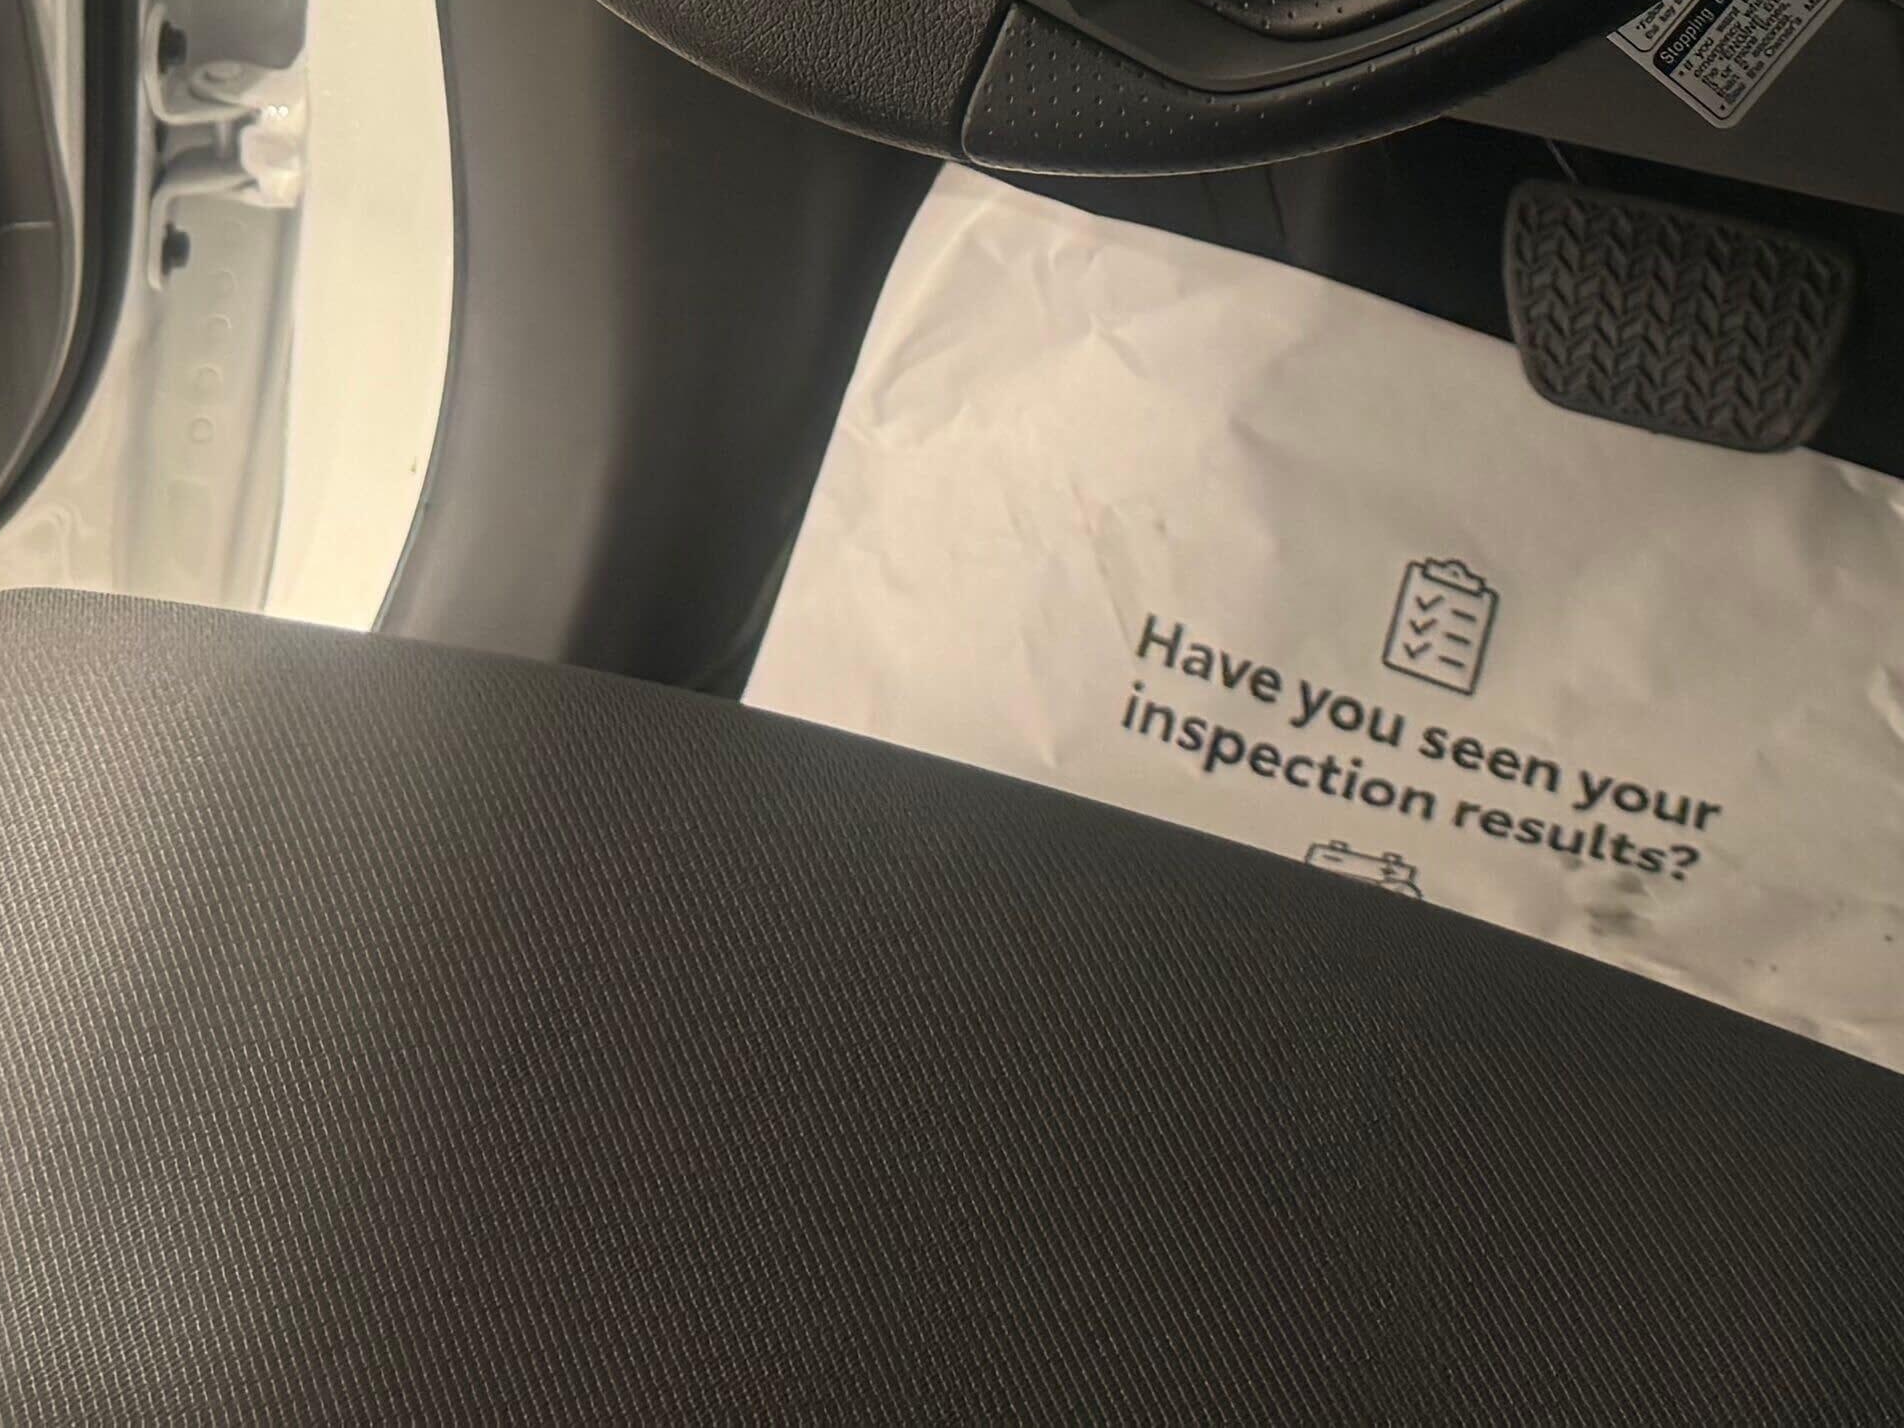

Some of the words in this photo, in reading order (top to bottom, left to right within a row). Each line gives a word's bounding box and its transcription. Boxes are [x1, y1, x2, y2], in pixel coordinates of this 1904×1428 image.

[1659, 6, 1716, 67] Stopping
[1693, 36, 1716, 60] you
[1121, 680, 1436, 821] inspection
[1453, 796, 1701, 882] results?
[1135, 612, 1284, 705] Have
[1291, 679, 1405, 749] you
[1421, 725, 1561, 793] seen
[1573, 768, 1722, 832] your
